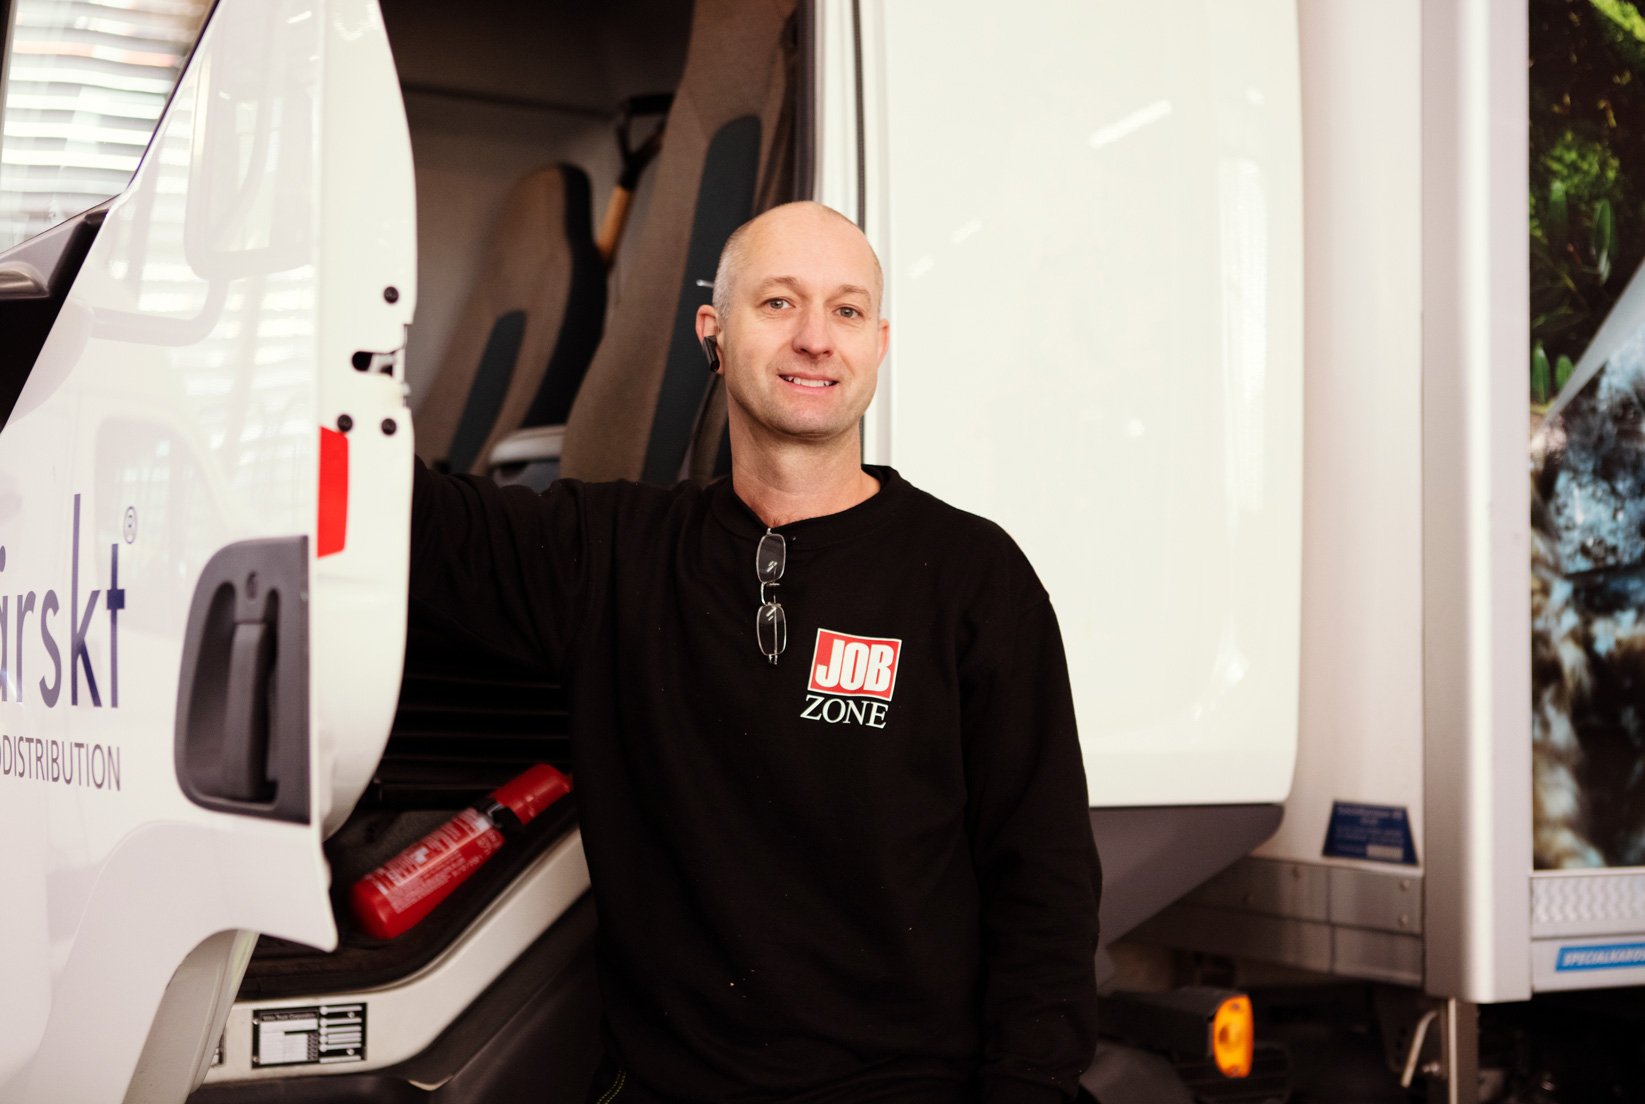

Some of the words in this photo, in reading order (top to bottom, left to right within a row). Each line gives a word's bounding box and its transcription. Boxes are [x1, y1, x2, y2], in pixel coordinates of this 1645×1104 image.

[815, 638, 895, 692] JOB
[800, 694, 889, 729] ZONE
[0, 734, 121, 792] DISTRIBUTION
